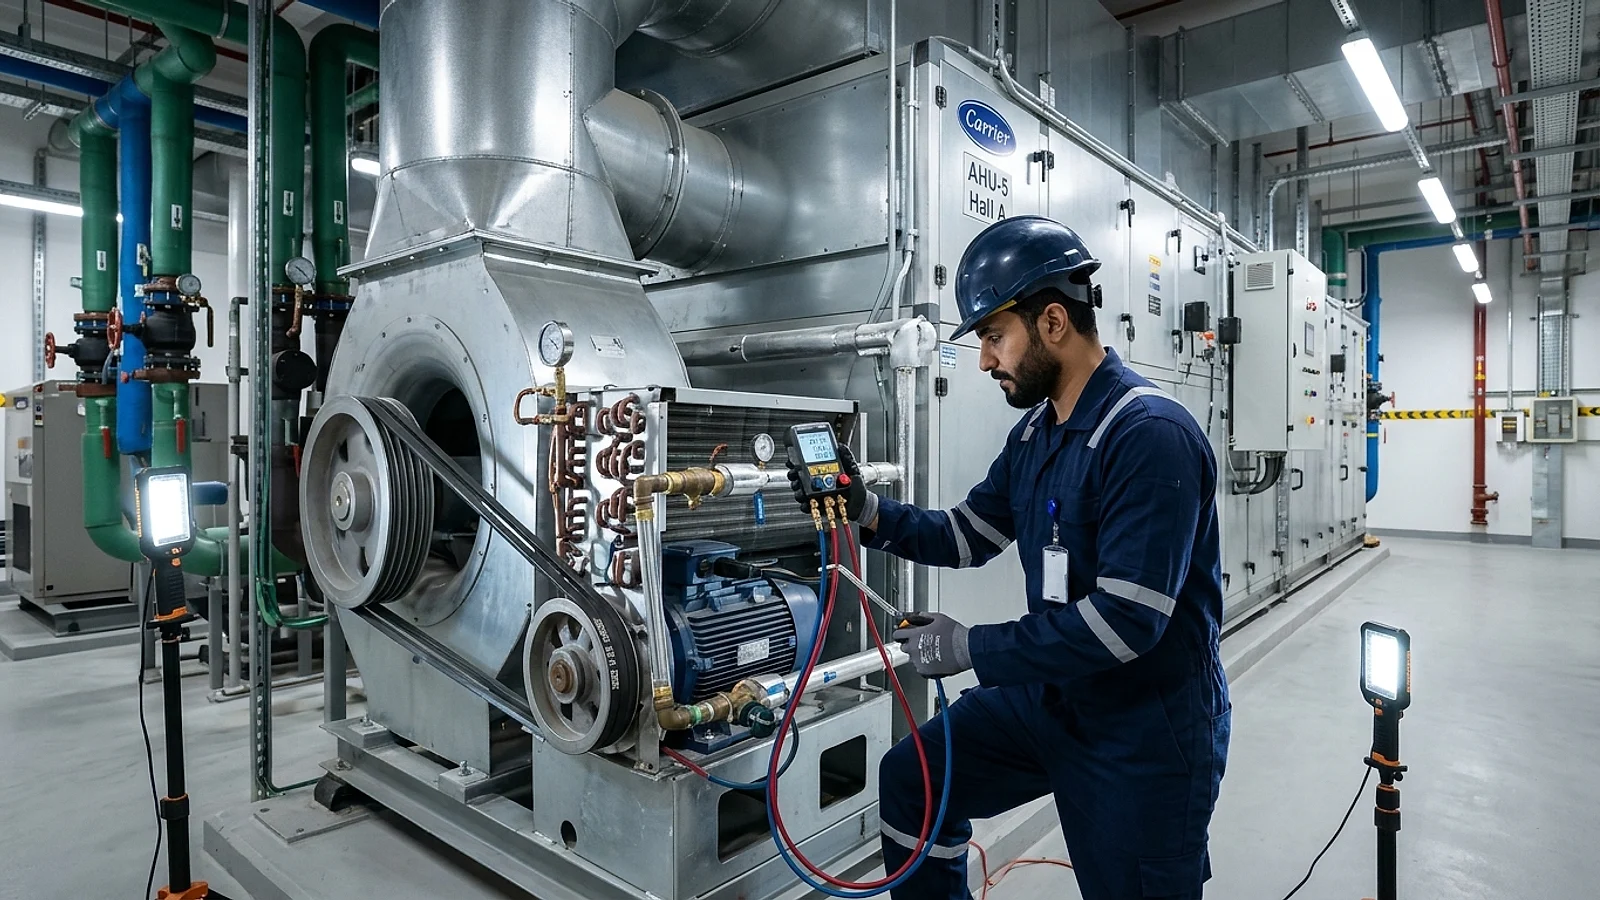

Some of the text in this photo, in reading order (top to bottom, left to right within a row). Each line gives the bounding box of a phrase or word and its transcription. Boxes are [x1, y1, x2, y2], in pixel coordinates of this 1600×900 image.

[966, 109, 1010, 145] Carrier
[968, 161, 1008, 197] AHU-5
[969, 190, 1007, 220] Hall A
